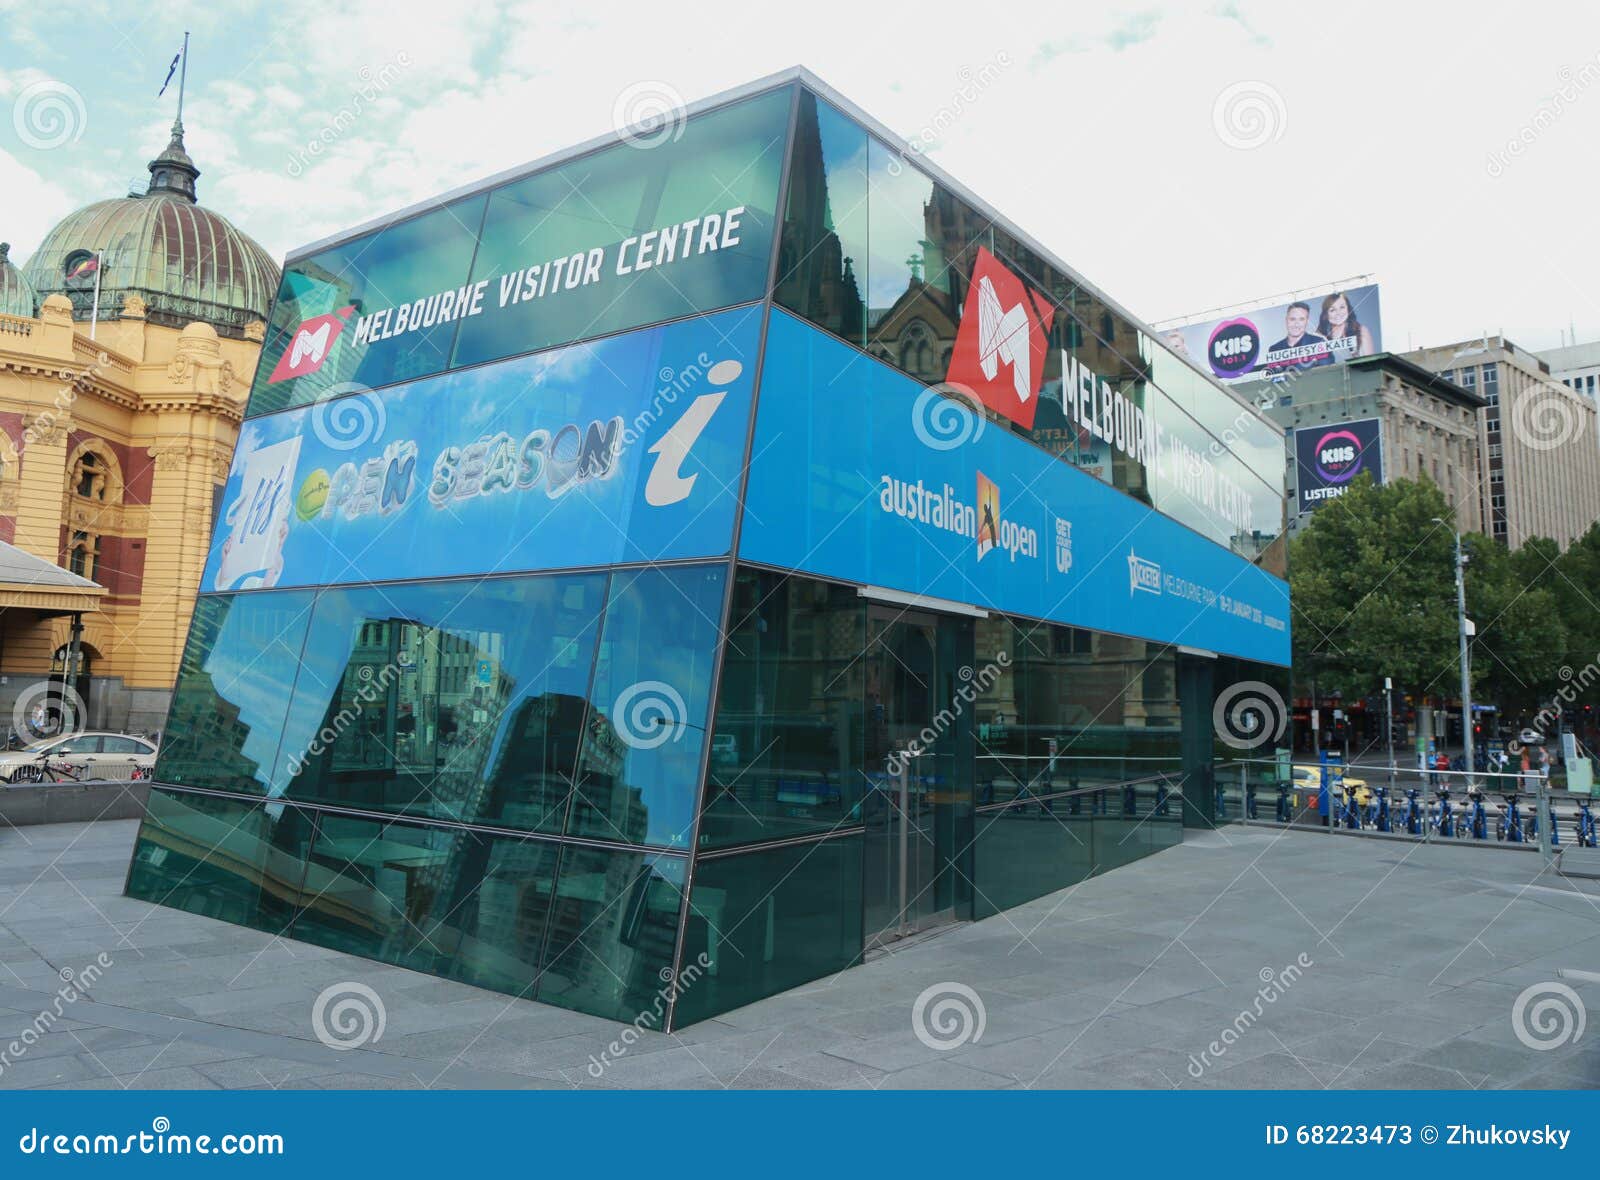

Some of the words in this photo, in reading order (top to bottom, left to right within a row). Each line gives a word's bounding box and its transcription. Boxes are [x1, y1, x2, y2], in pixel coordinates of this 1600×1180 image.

[352, 281, 489, 347] MELBOURNE
[499, 247, 604, 308] VISITOR
[616, 206, 745, 276] CENTRE
[1214, 335, 1253, 358] KIIS
[1061, 348, 1166, 479] MELBOURNE
[296, 440, 418, 521] OPEN
[428, 415, 625, 510] SEASON
[1321, 446, 1354, 464] KIIS
[1304, 486, 1343, 500] LISTEN
[880, 475, 976, 539] australian
[1001, 519, 1038, 563] open
[1056, 517, 1072, 538] GET
[1056, 544, 1073, 574] UP
